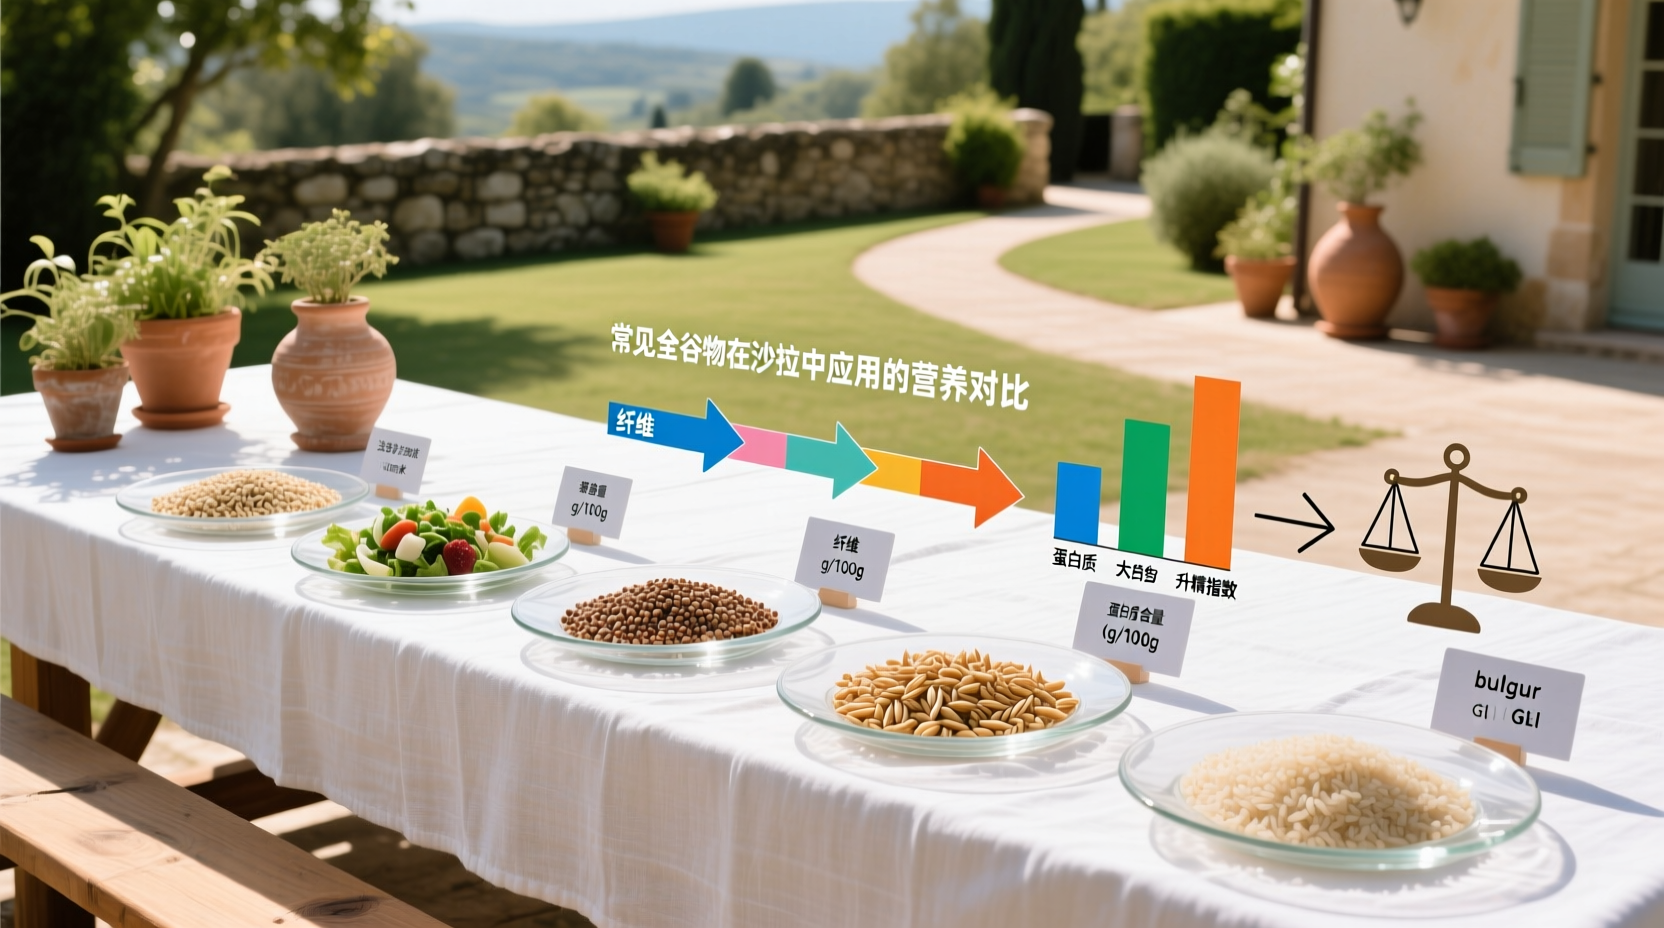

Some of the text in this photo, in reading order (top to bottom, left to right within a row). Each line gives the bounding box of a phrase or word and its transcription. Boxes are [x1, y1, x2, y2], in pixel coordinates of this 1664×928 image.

[832, 533, 860, 554] 纤维
[820, 558, 865, 582] g/100g
[1102, 623, 1160, 654] (g/100g
[1474, 669, 1542, 700] bulgur
